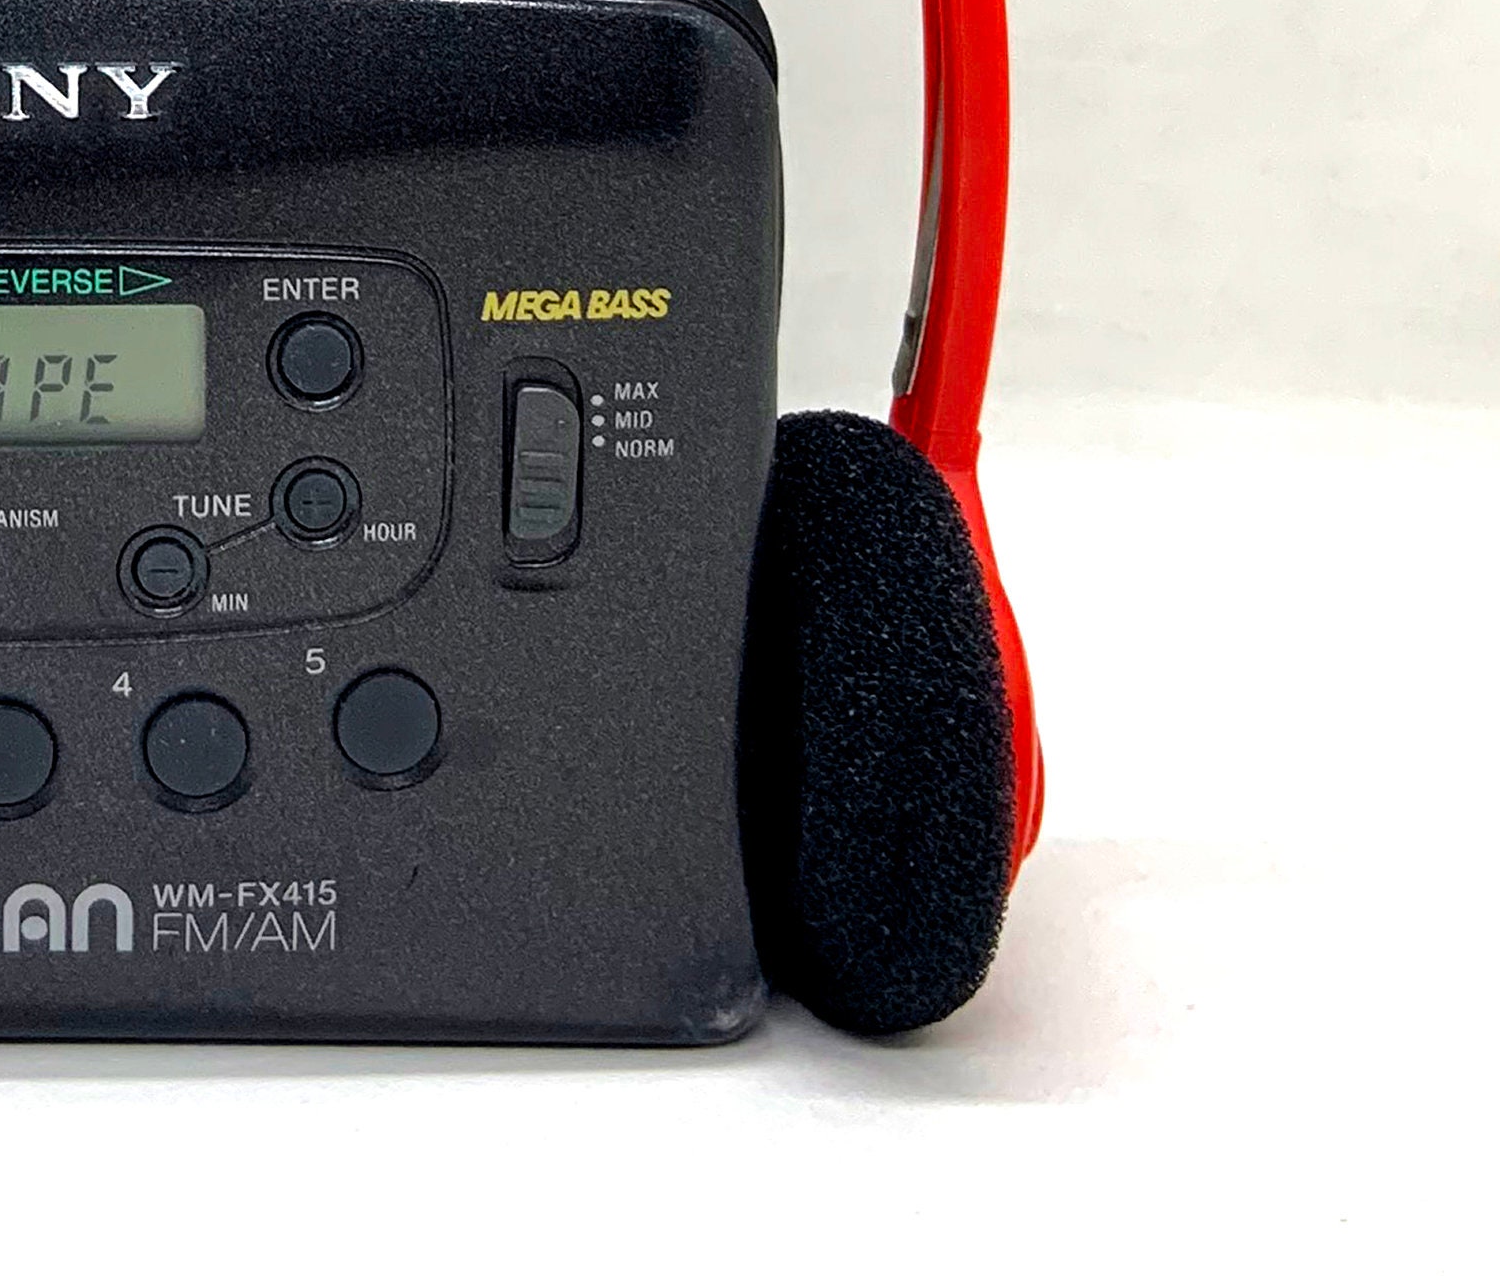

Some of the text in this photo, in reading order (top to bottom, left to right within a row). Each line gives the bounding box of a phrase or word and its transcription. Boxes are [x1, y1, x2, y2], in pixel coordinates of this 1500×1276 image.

[264, 278, 359, 300] ENTER
[481, 289, 671, 321] MEGA BASS
[615, 383, 658, 399] MAX
[616, 411, 652, 429] MID
[616, 439, 673, 457] NORM
[173, 494, 251, 518] TUNE
[364, 523, 416, 541] HOUR
[212, 594, 248, 611] MIN
[306, 649, 325, 674] 5
[112, 672, 132, 696] 4
[153, 880, 336, 908] WM-FX415
[154, 911, 335, 952] FM/AM
